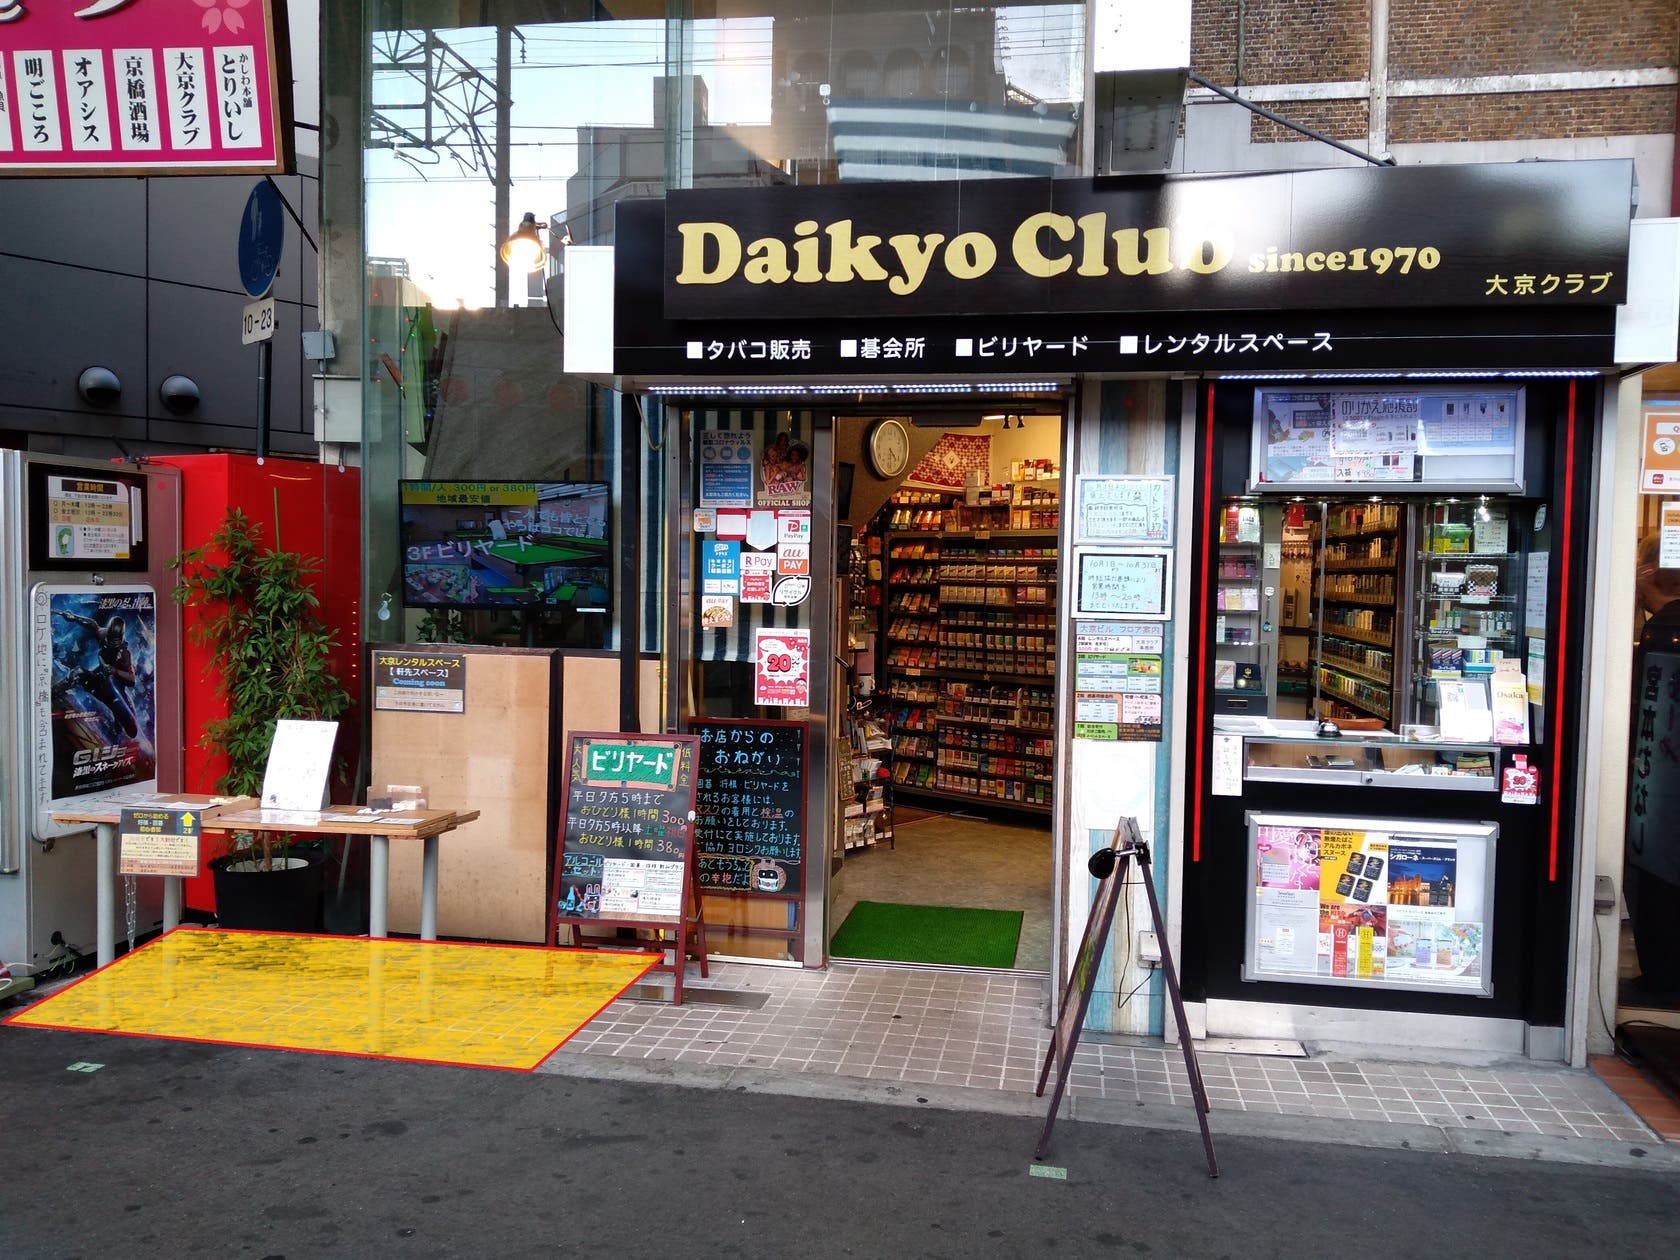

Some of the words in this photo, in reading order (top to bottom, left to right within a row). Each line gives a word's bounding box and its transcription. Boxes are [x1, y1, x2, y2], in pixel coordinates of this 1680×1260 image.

[239, 53, 253, 108] かしわ本舗
[25, 57, 50, 144] 明ごころ
[74, 57, 100, 143] オアシス
[124, 56, 150, 143] 京橋酒場
[174, 52, 201, 145] 大京クラブ
[221, 54, 243, 142] とりいし
[675, 219, 997, 296] Daikyo
[1012, 211, 1235, 278] Club
[1247, 246, 1441, 275] since1970
[1485, 271, 1614, 296] 大京クラブ
[243, 308, 273, 335] 10-23
[706, 338, 811, 360] タバコ販売
[860, 337, 926, 360] 碁会所
[978, 335, 1088, 358] ビリヤード
[1143, 332, 1334, 354] レンタルスペース
[767, 481, 800, 496] RAW
[437, 533, 534, 558] ビリヤード
[782, 548, 805, 558] au
[754, 556, 773, 568] Pay
[783, 561, 804, 570] PAY
[1080, 625, 1114, 633] 大京ビル
[1120, 625, 1160, 633] フロア案内
[379, 656, 460, 668] 大京レンタルスペース
[767, 654, 791, 672] 20
[392, 678, 425, 687] Coming
[700, 728, 774, 744] お店からの
[571, 745, 582, 782] 大人気
[592, 750, 673, 775] ビリヤード
[680, 748, 691, 784] 低料金
[715, 749, 780, 765] おねがい
[744, 780, 789, 792] ビリヤードを
[573, 790, 664, 805] 平日夕方5時まで
[568, 817, 643, 835] 平日夕方5時以降
[564, 855, 604, 867] アルコール
[1390, 853, 1419, 862] シガローネ
[572, 866, 598, 876] セット
